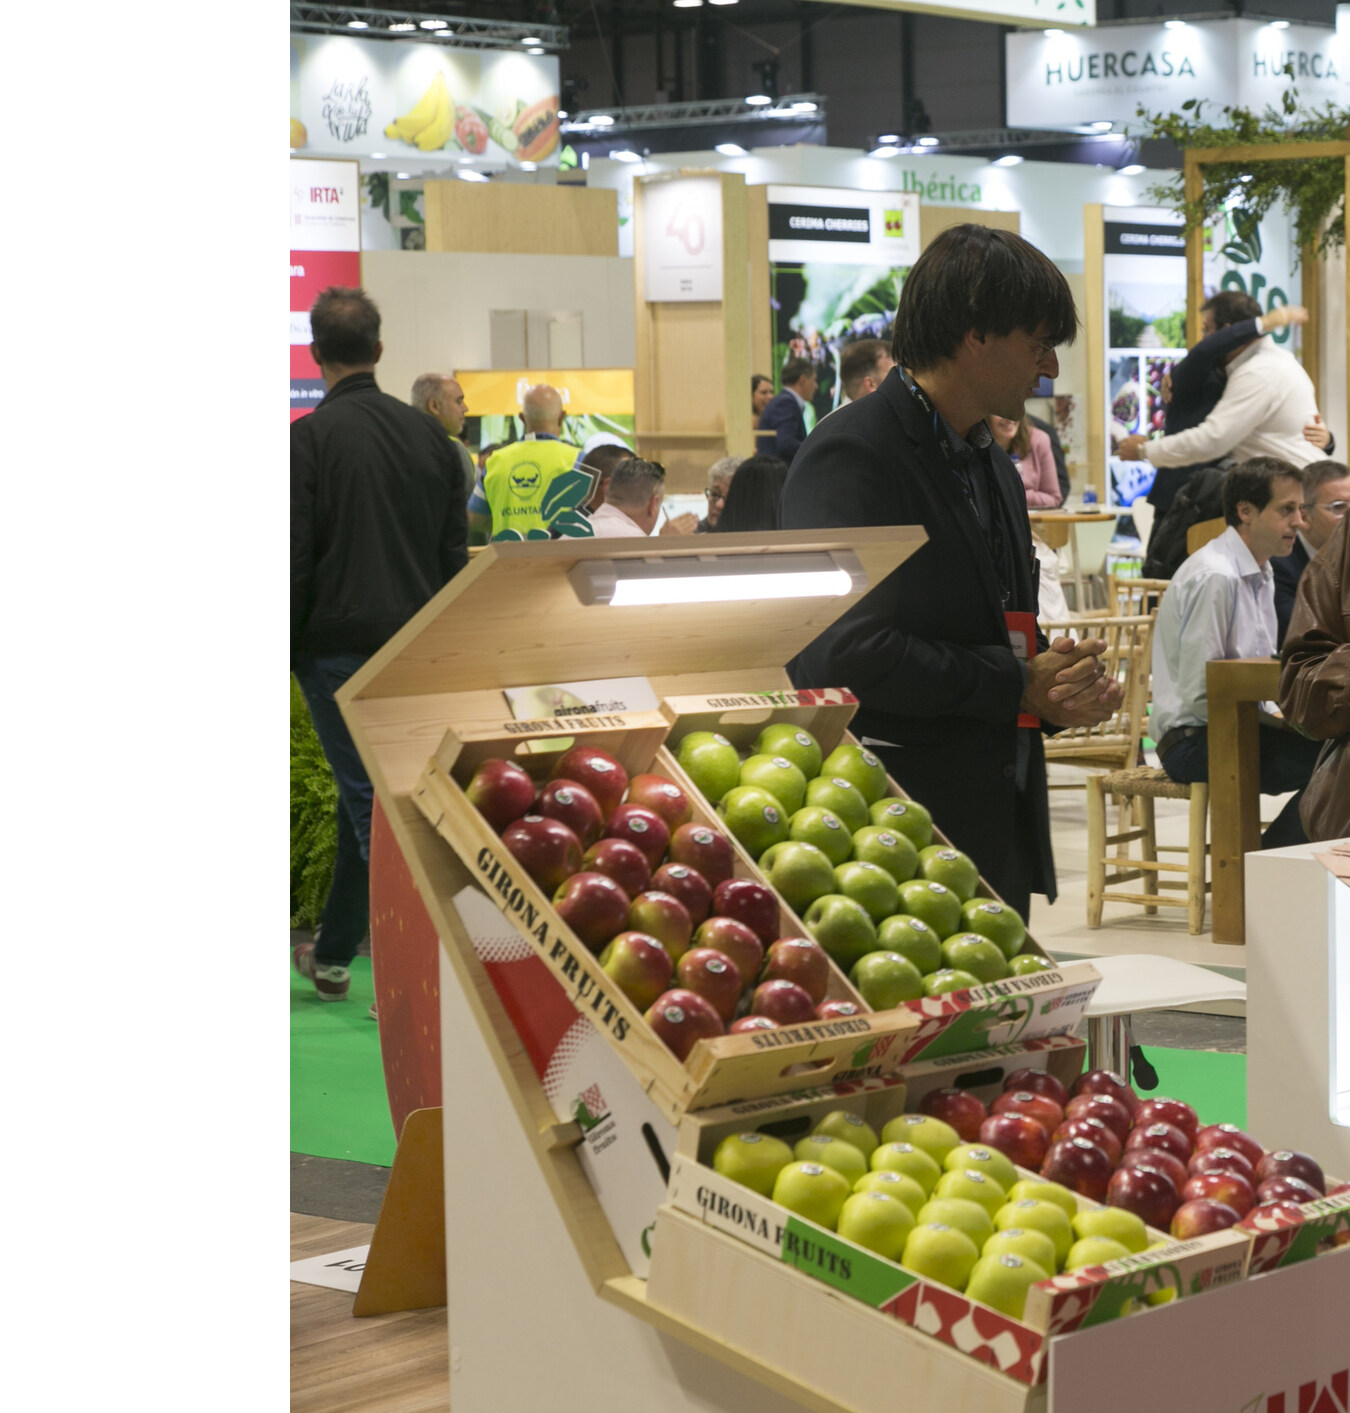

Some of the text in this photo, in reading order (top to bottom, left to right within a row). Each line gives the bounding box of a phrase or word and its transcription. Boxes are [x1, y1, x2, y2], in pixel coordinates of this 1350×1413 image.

[1046, 50, 1196, 85] HUERCASA
[902, 169, 982, 202] Ibérica
[825, 218, 869, 232] CHERRIES
[504, 715, 626, 734] GIRONA FRUITS
[477, 847, 630, 1041] GIRONA FRUITS
[1010, 971, 1064, 994] GIRONA
[751, 1018, 871, 1049] GIRONA FRUITS
[696, 1185, 852, 1280] GIRONA FRUITS
